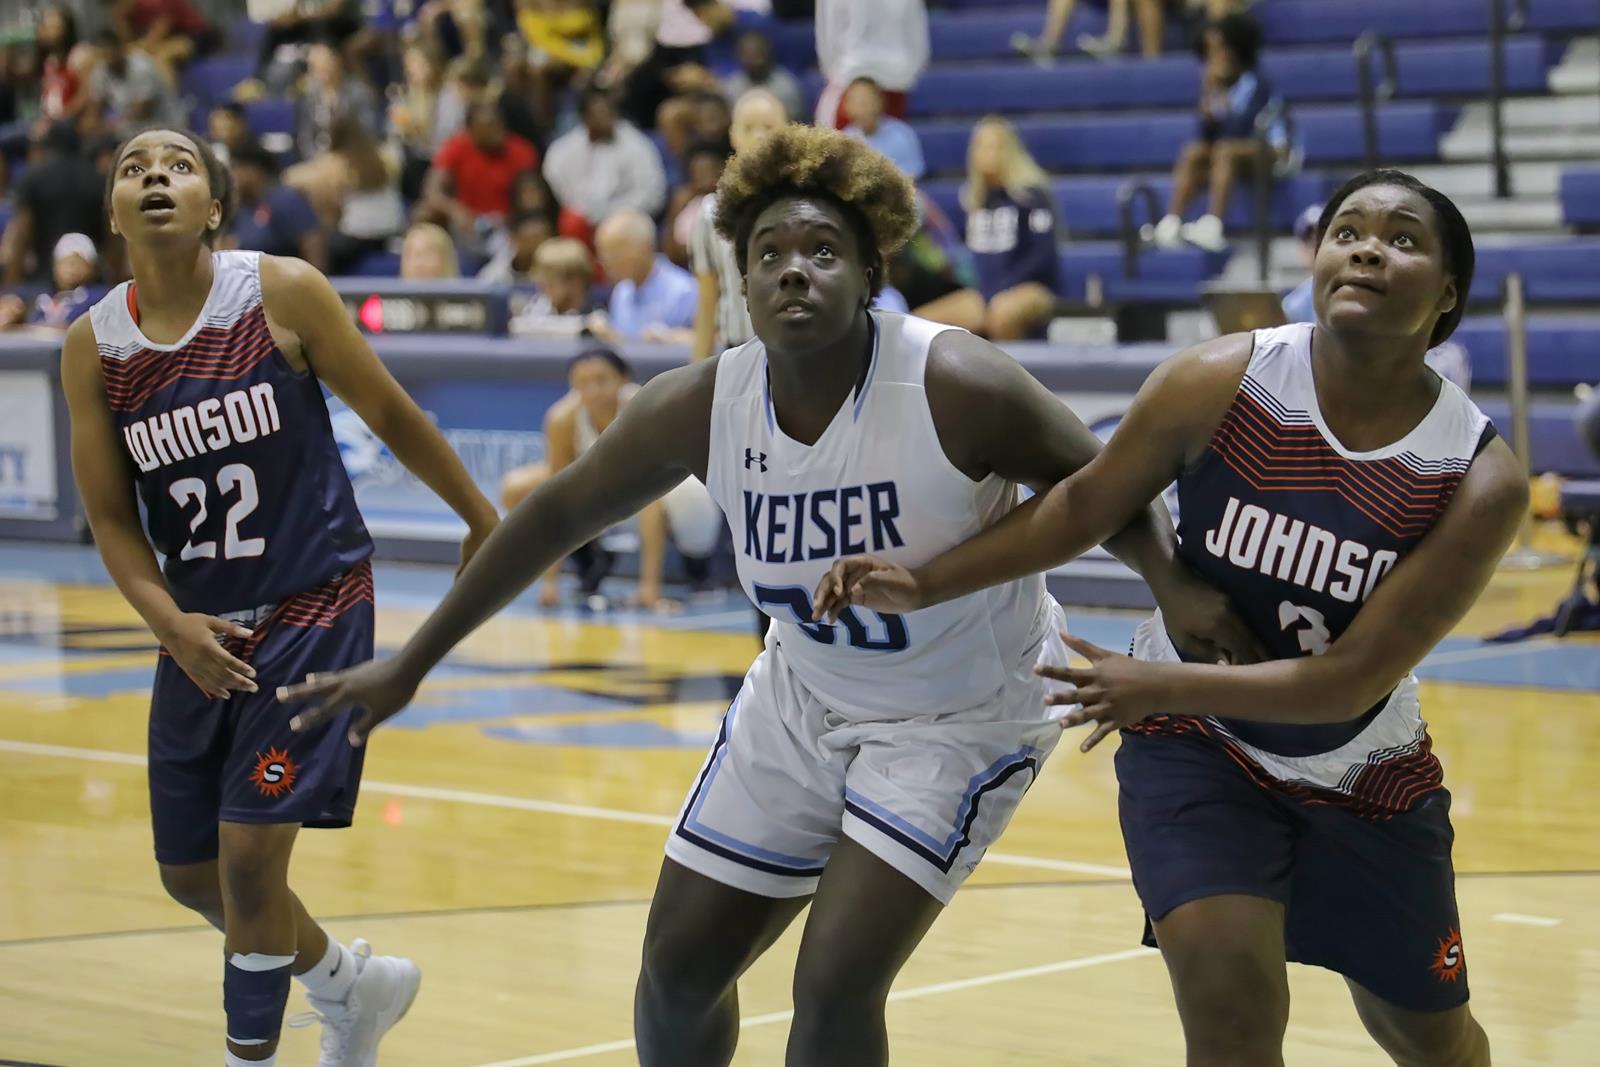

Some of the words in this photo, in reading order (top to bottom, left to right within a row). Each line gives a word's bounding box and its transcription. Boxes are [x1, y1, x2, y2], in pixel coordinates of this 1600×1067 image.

[123, 382, 280, 473] JOHNSON
[168, 462, 266, 561] 22
[743, 480, 906, 564] KEISER
[1204, 496, 1398, 603] JOHNSO
